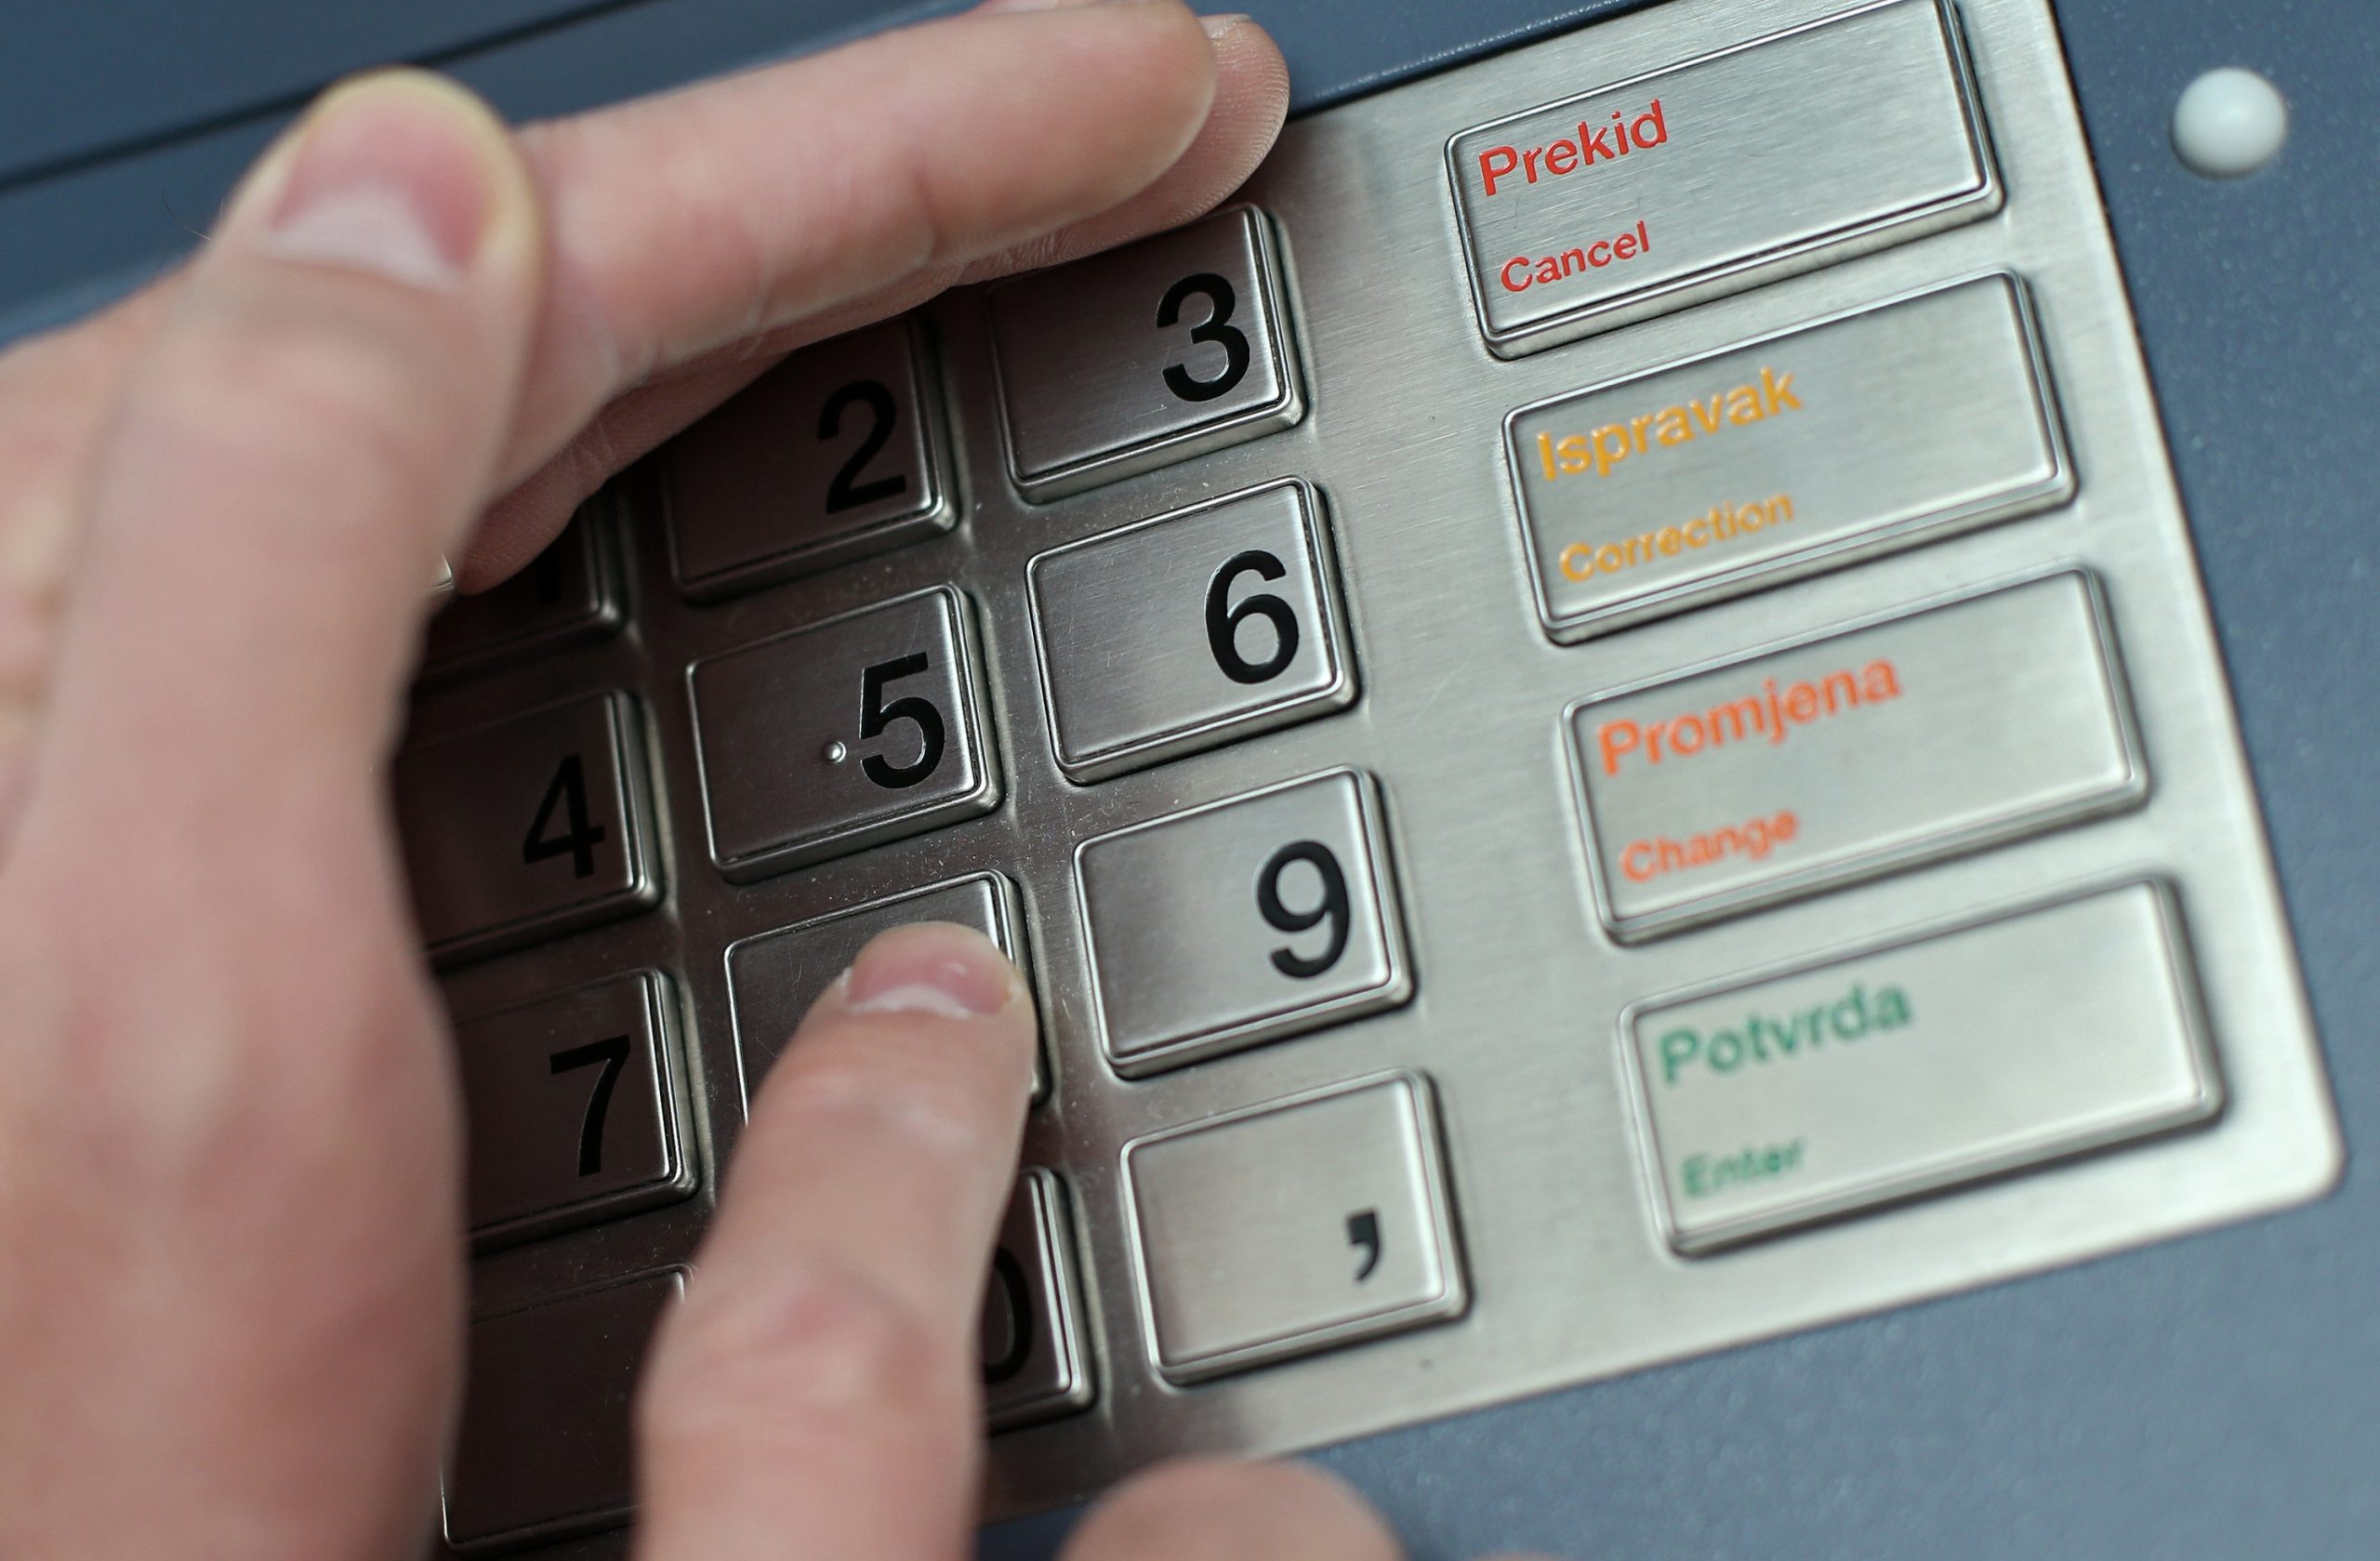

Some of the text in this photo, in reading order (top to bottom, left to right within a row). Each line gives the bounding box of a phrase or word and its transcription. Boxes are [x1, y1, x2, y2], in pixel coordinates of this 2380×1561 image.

[1478, 99, 1669, 196] Prekid
[1500, 220, 1651, 293] Cancel
[1156, 272, 1250, 403] 3
[816, 379, 906, 514] 2
[1537, 367, 1803, 481] Ispravak
[1559, 493, 1795, 583] Correction
[1205, 550, 1299, 684] 6
[859, 653, 945, 789] 5
[1598, 659, 1901, 775] Promjena
[523, 754, 605, 879] 4
[1620, 811, 1800, 883] Change
[1256, 840, 1350, 979] 9
[1659, 982, 1913, 1084] Potvrda
[550, 1035, 630, 1176] 7
[1681, 1138, 1805, 1198] Enter
